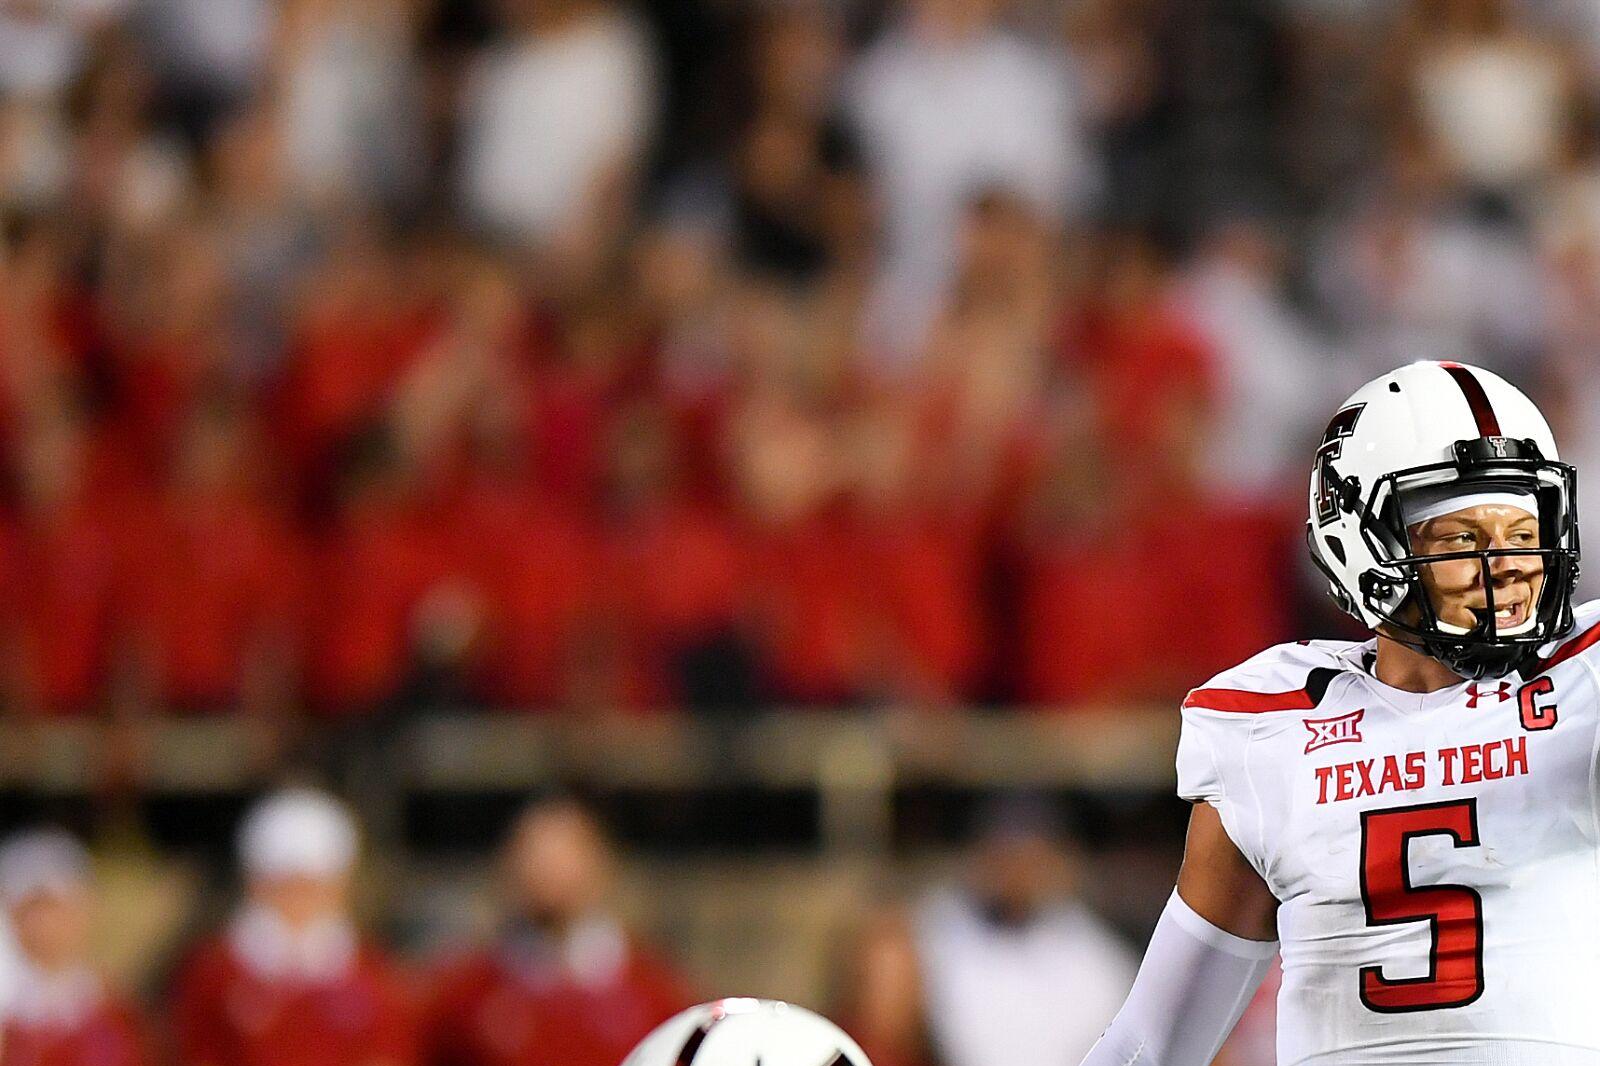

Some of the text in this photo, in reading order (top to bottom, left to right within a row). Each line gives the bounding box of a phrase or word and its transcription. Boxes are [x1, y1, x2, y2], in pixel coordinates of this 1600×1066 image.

[1516, 676, 1557, 732] C
[1315, 737, 1528, 804] TEXAS TECH
[1359, 797, 1484, 1014] 5
